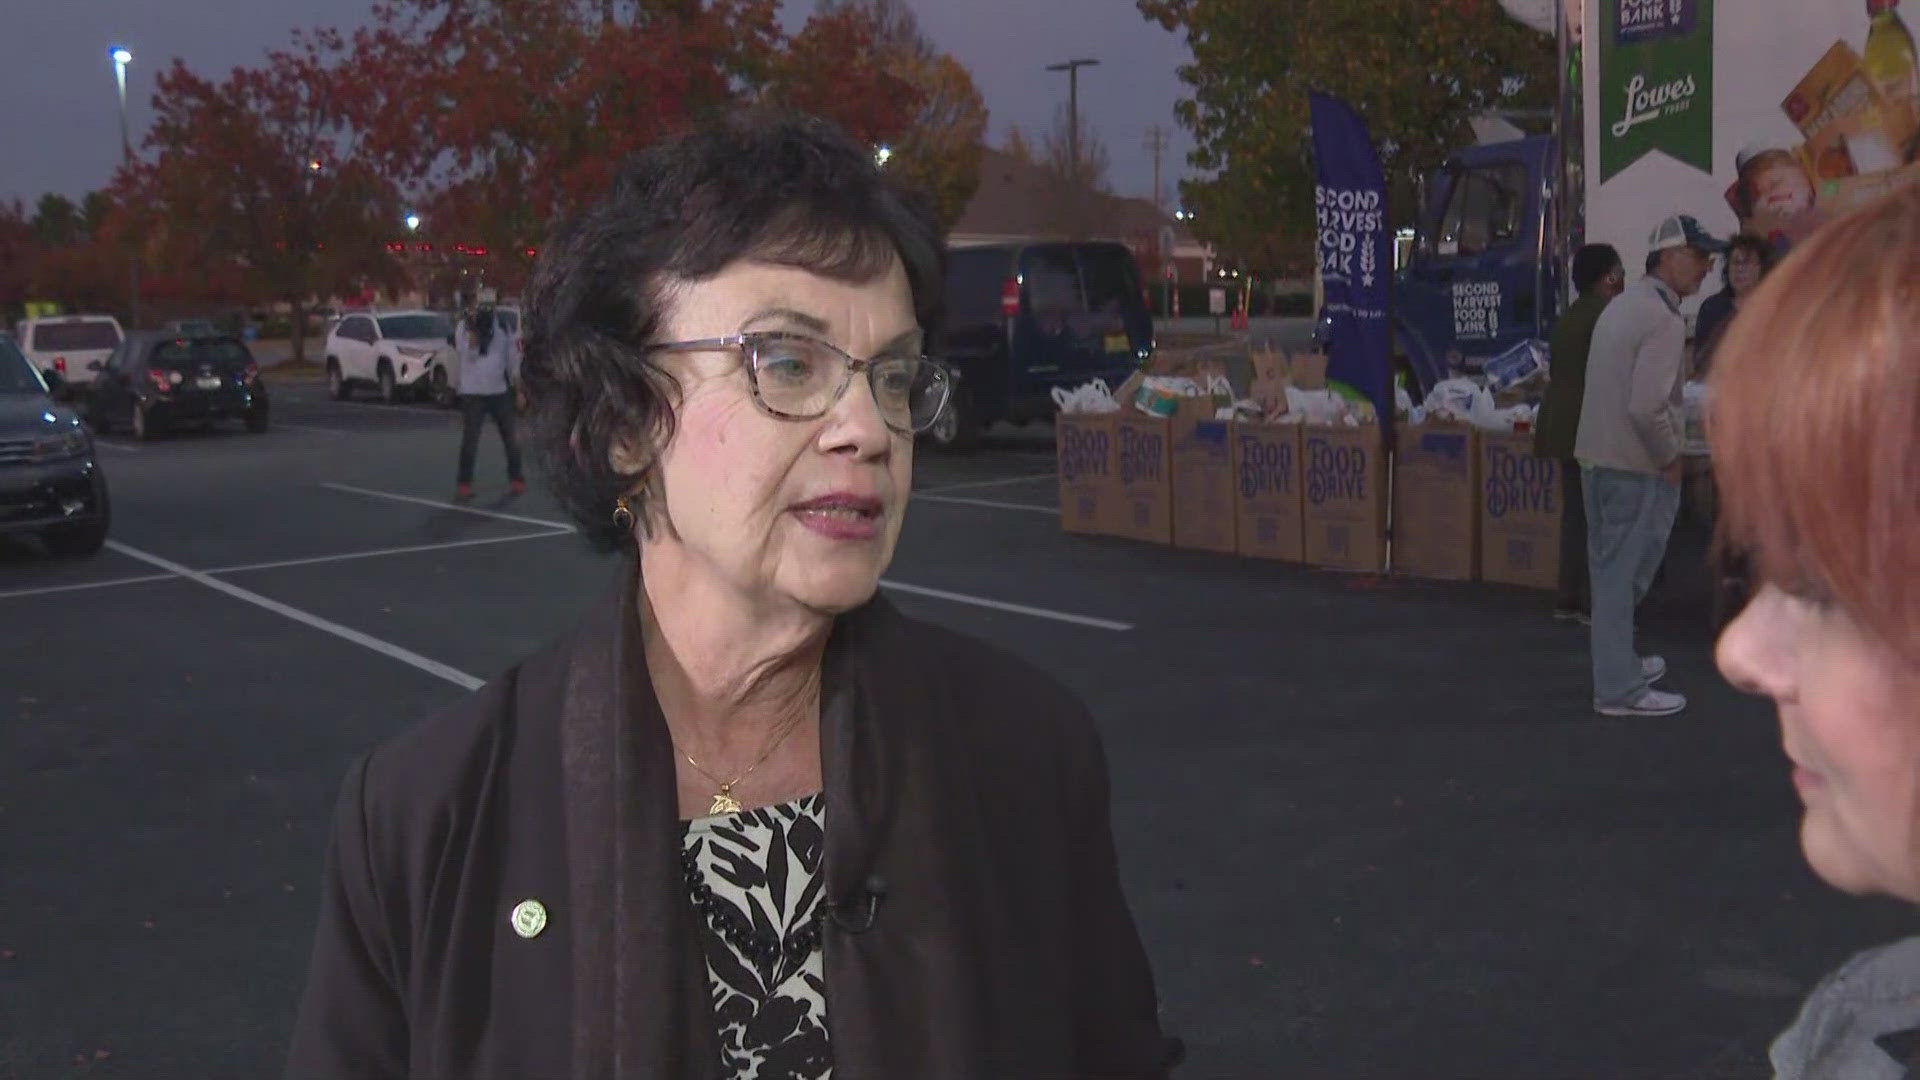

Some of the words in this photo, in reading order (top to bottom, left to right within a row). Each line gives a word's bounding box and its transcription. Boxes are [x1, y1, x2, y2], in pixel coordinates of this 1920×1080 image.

[1620, 3, 1664, 25] BANK
[1612, 74, 1696, 137] Lowes
[1452, 281, 1499, 296] SECOND
[1453, 293, 1502, 309] HARVEST
[1454, 309, 1486, 321] FOOD
[1455, 320, 1486, 333] BANK
[1239, 435, 1292, 469] FOOD
[1306, 437, 1366, 475] FOOD
[1488, 446, 1554, 485] FOOD
[1239, 461, 1292, 499] DRIVE
[1306, 467, 1367, 505] DRIVE
[1487, 478, 1553, 517] DRIVE
